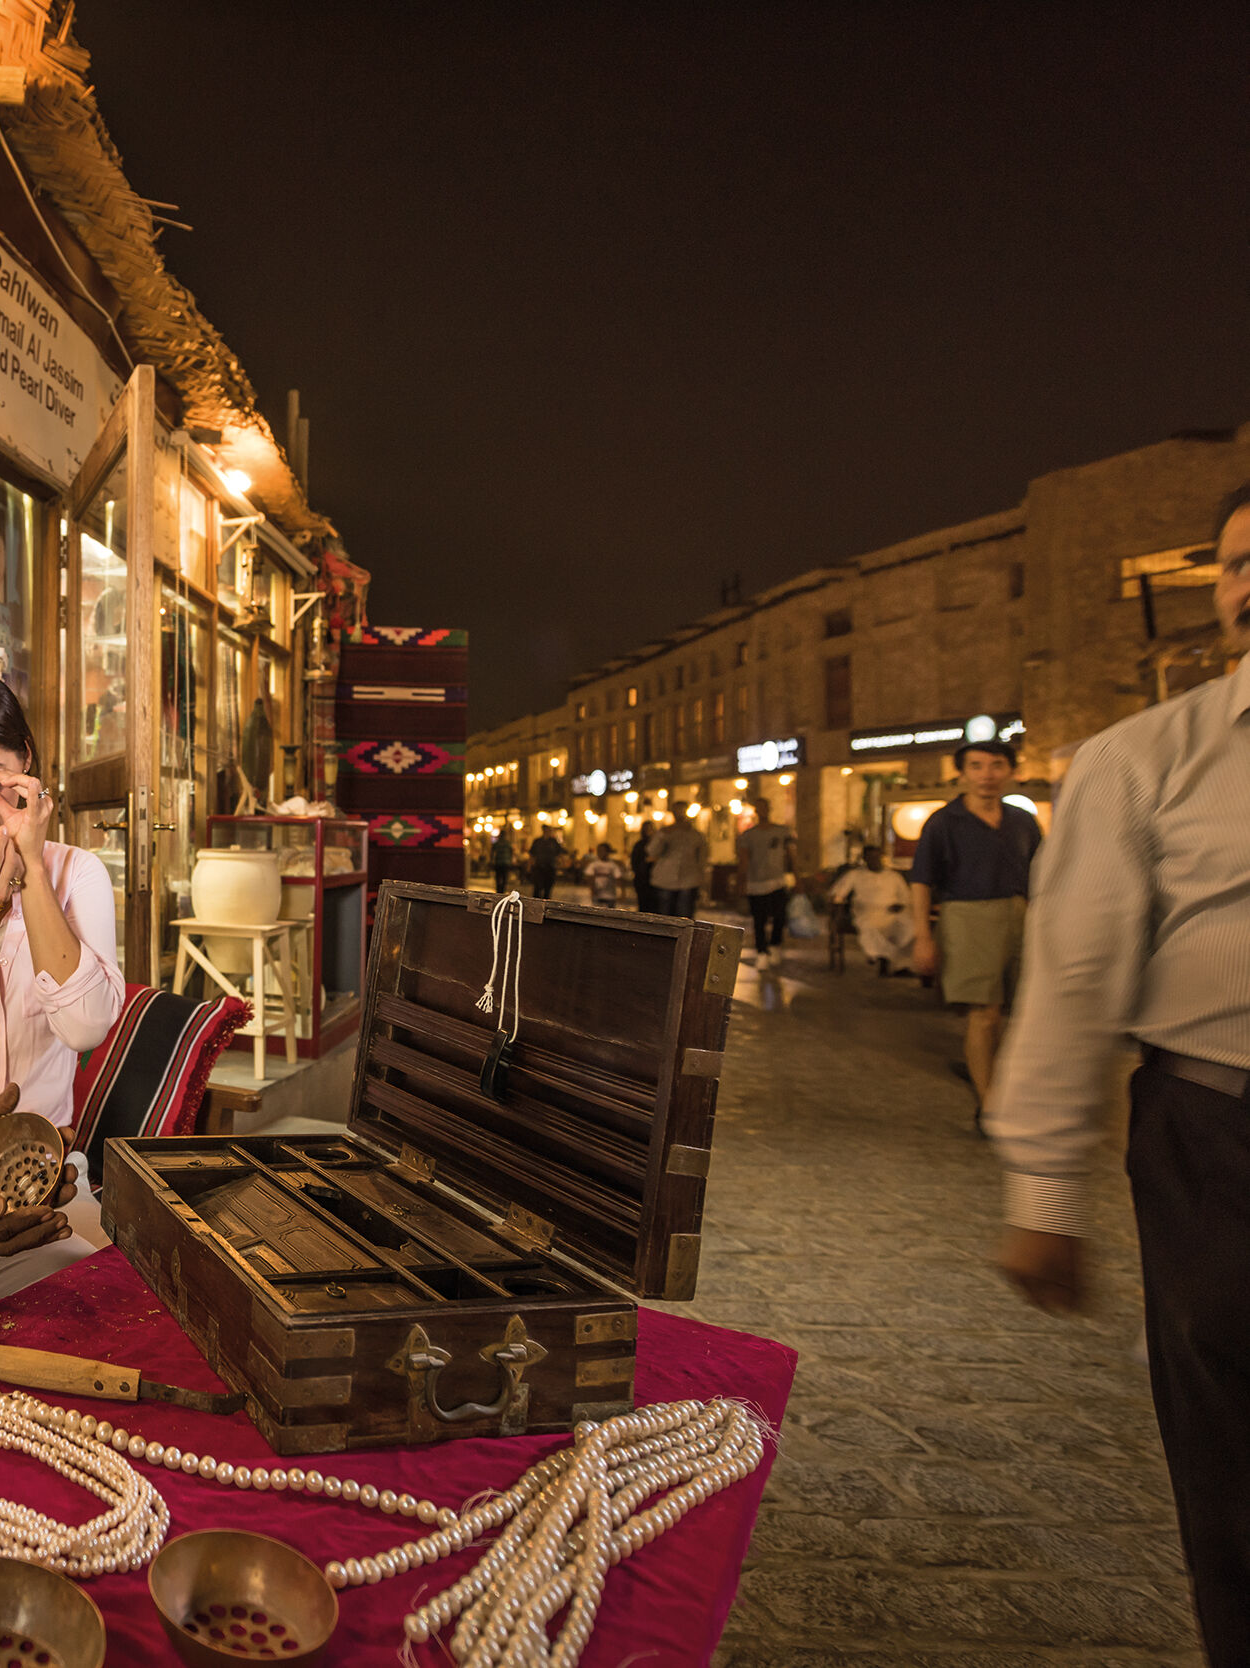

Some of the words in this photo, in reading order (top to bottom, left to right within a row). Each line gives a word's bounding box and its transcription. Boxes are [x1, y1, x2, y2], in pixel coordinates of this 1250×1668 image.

[10, 353, 44, 405] Pearl
[45, 383, 77, 429] Diver
[26, 332, 42, 366] Al
[42, 347, 85, 403] Jassim
